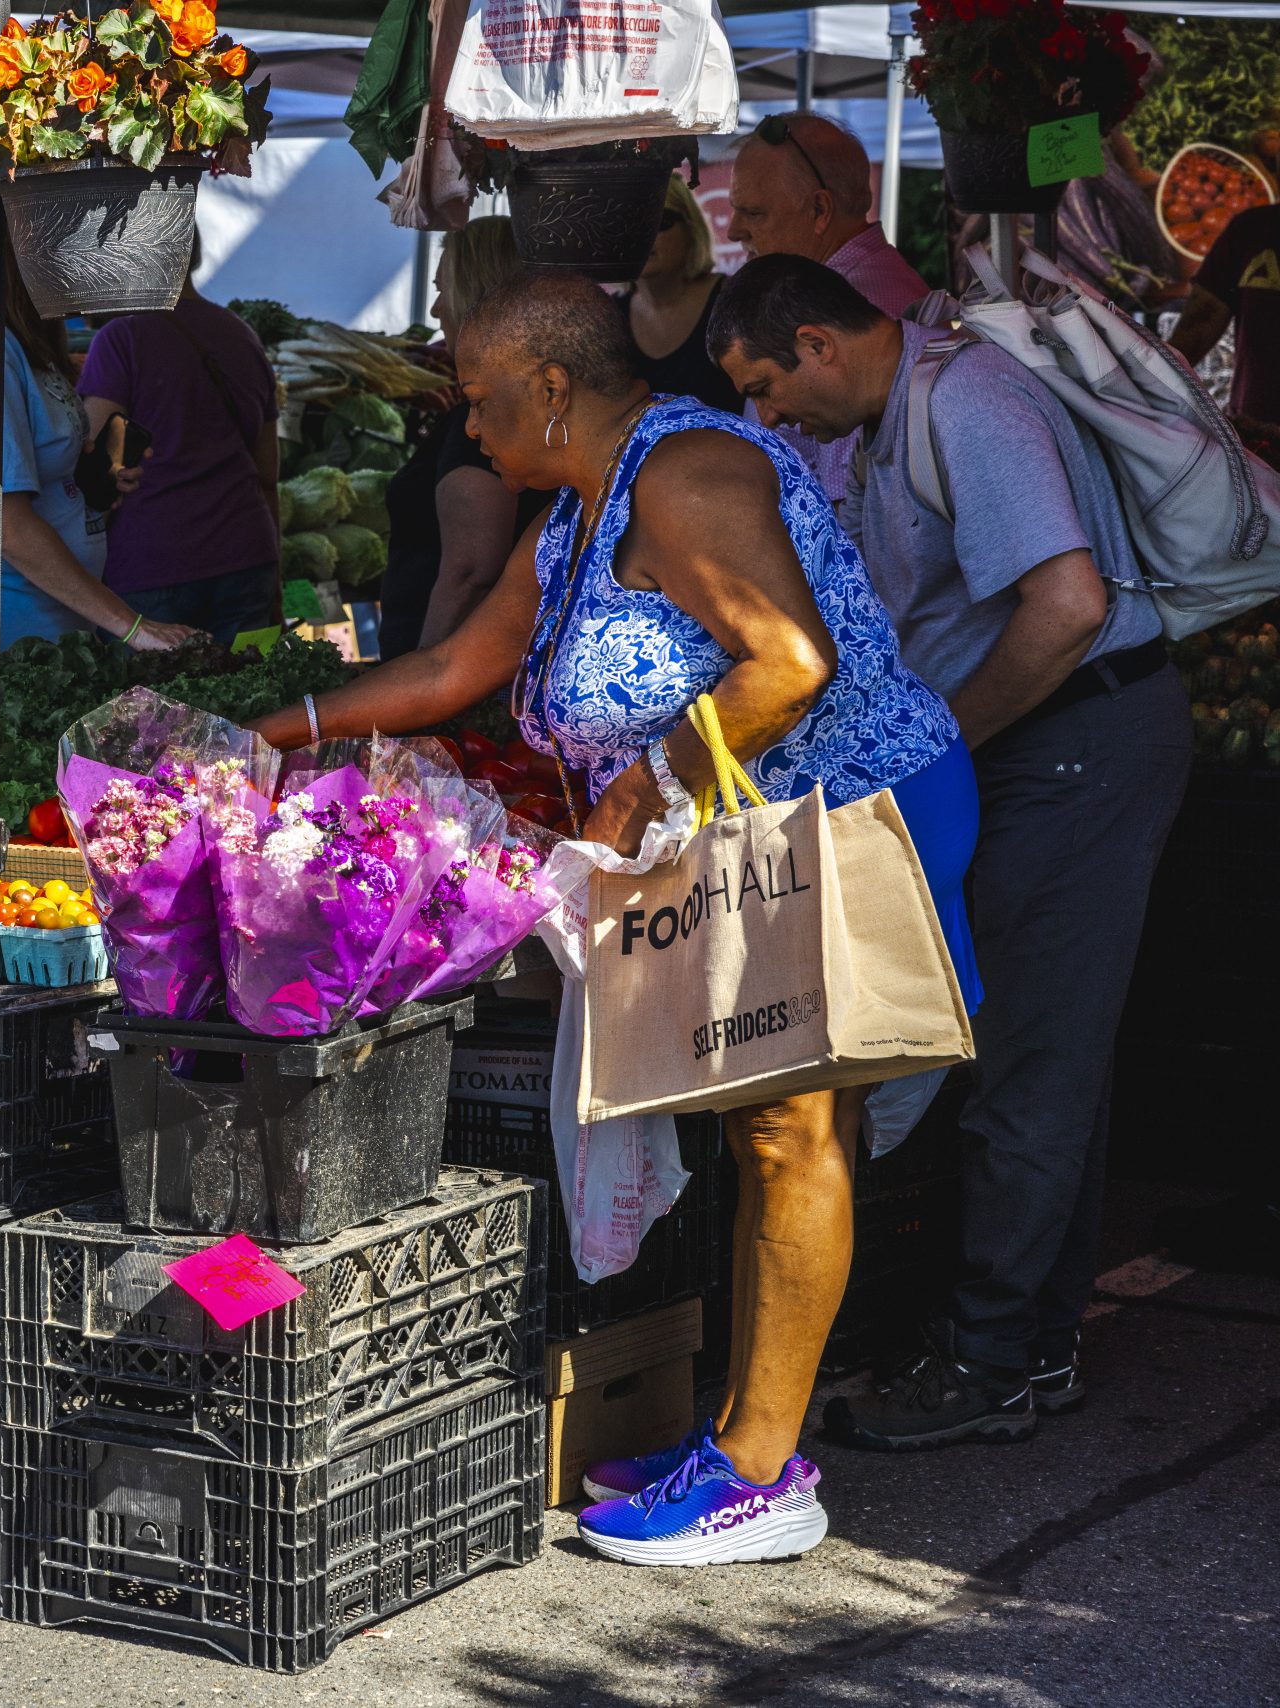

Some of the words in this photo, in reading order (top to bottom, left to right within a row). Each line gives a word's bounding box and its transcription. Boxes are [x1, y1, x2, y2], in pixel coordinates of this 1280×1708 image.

[578, 15, 603, 29] STORE
[603, 16, 619, 30] FOR
[619, 17, 661, 33] RECYCLING
[563, 903, 571, 917] TO
[575, 913, 588, 930] PAR
[478, 1055, 511, 1065] PRODUCE
[512, 1056, 520, 1065] OF
[698, 1494, 771, 1537] HOKA
